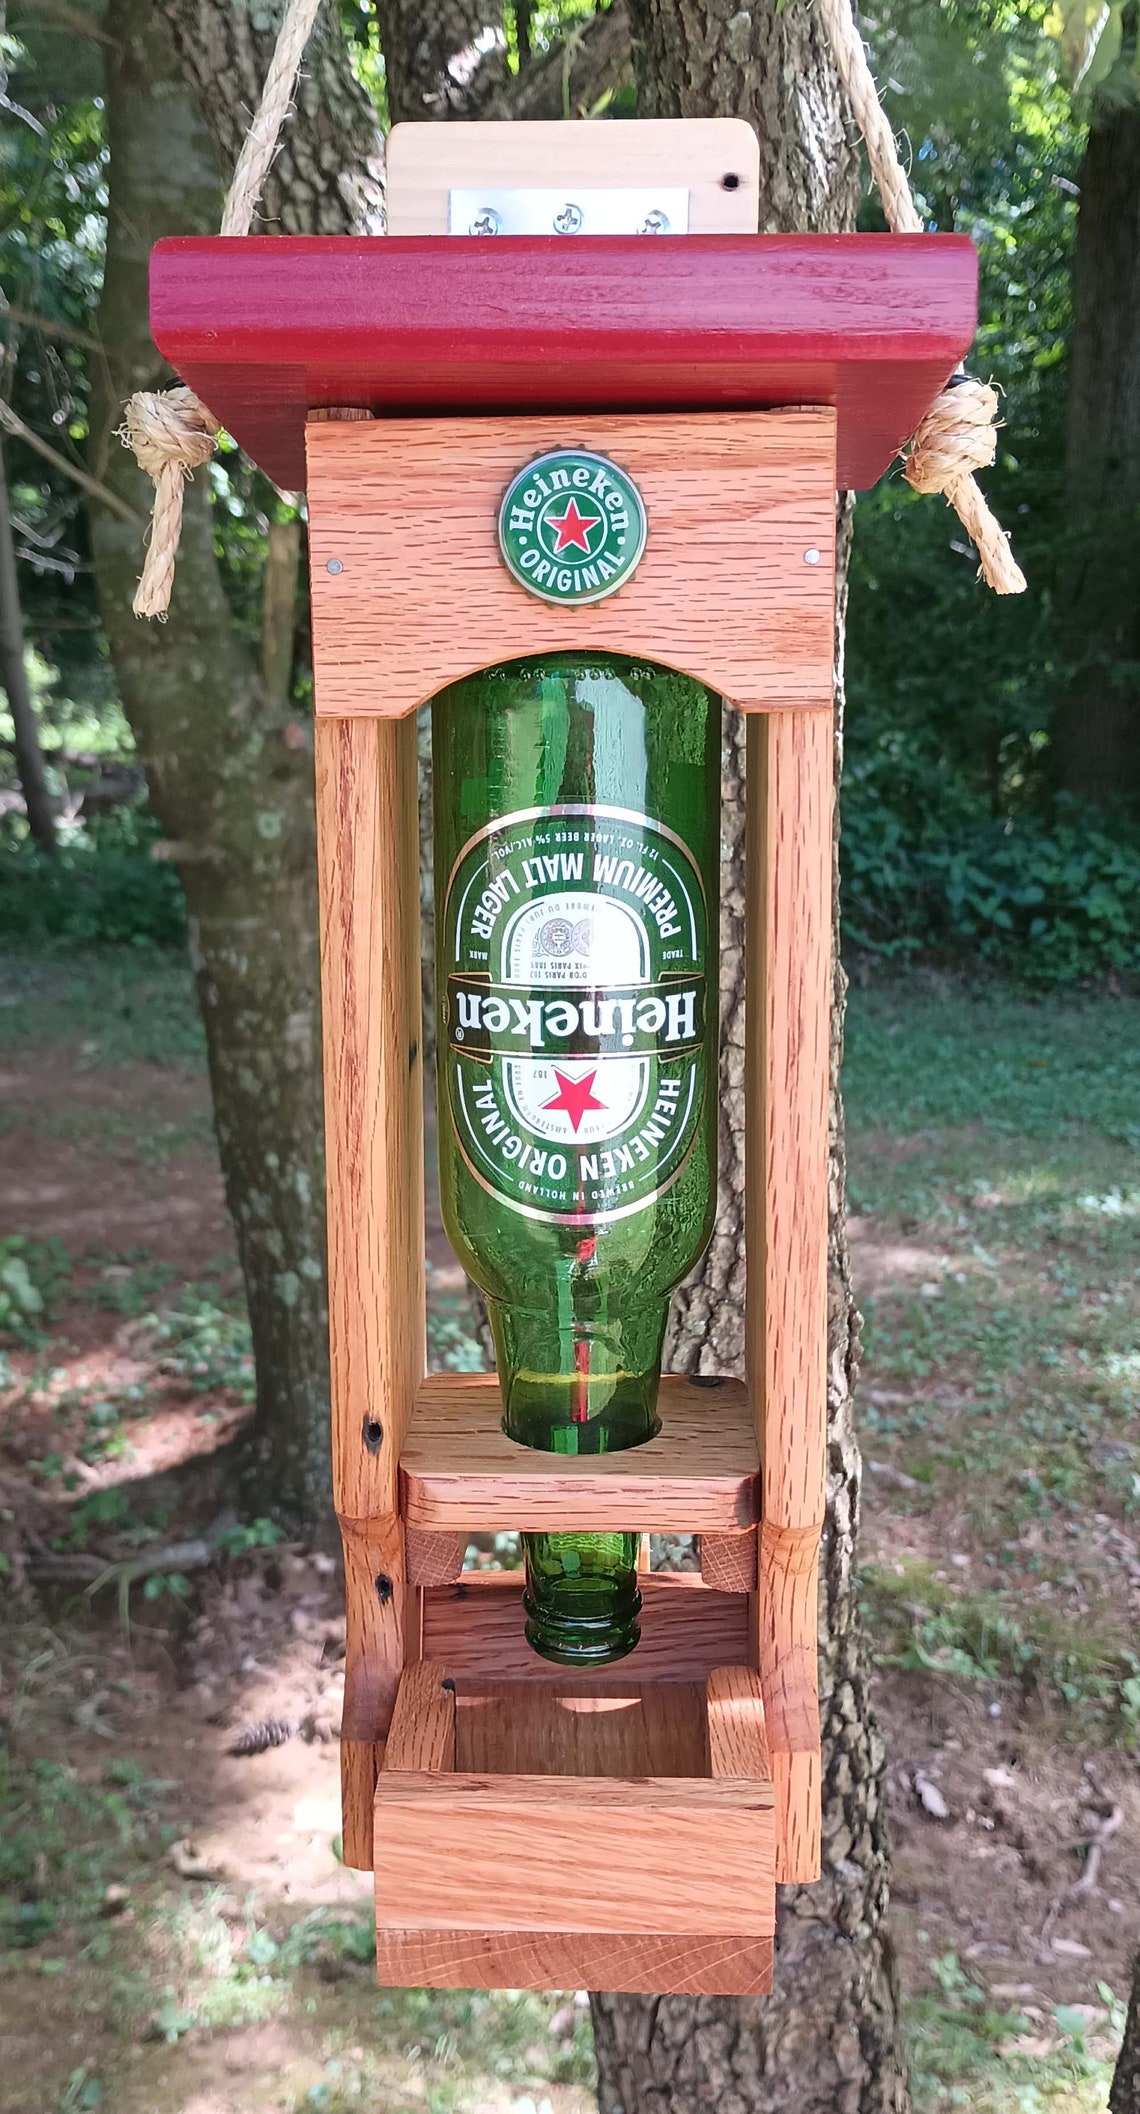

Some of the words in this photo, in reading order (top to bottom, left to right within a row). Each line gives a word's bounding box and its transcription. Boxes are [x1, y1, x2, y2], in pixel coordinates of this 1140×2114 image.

[509, 468, 629, 532] Heineken
[519, 549, 626, 592] ORIGINAL
[535, 833, 551, 845] 5%
[555, 832, 580, 842] BEER
[584, 832, 614, 844] LAGER
[618, 836, 634, 849] OZ.
[637, 841, 652, 854] FL.
[649, 851, 659, 861] 12
[521, 852, 584, 889] MALT
[593, 853, 682, 939] PREMIUM
[470, 868, 521, 940] LAGER
[469, 950, 488, 961] MARK
[662, 949, 684, 961] TRADE
[550, 961, 572, 970] PARIS
[544, 971, 566, 979] PARIS
[569, 971, 588, 979] D'OR
[472, 1078, 567, 1181] ORIGINAL
[580, 1078, 681, 1181] HEINEKEN
[518, 1181, 566, 1200] HOLLAND
[573, 1191, 585, 1201] IN
[591, 1180, 635, 1200] BREWED
